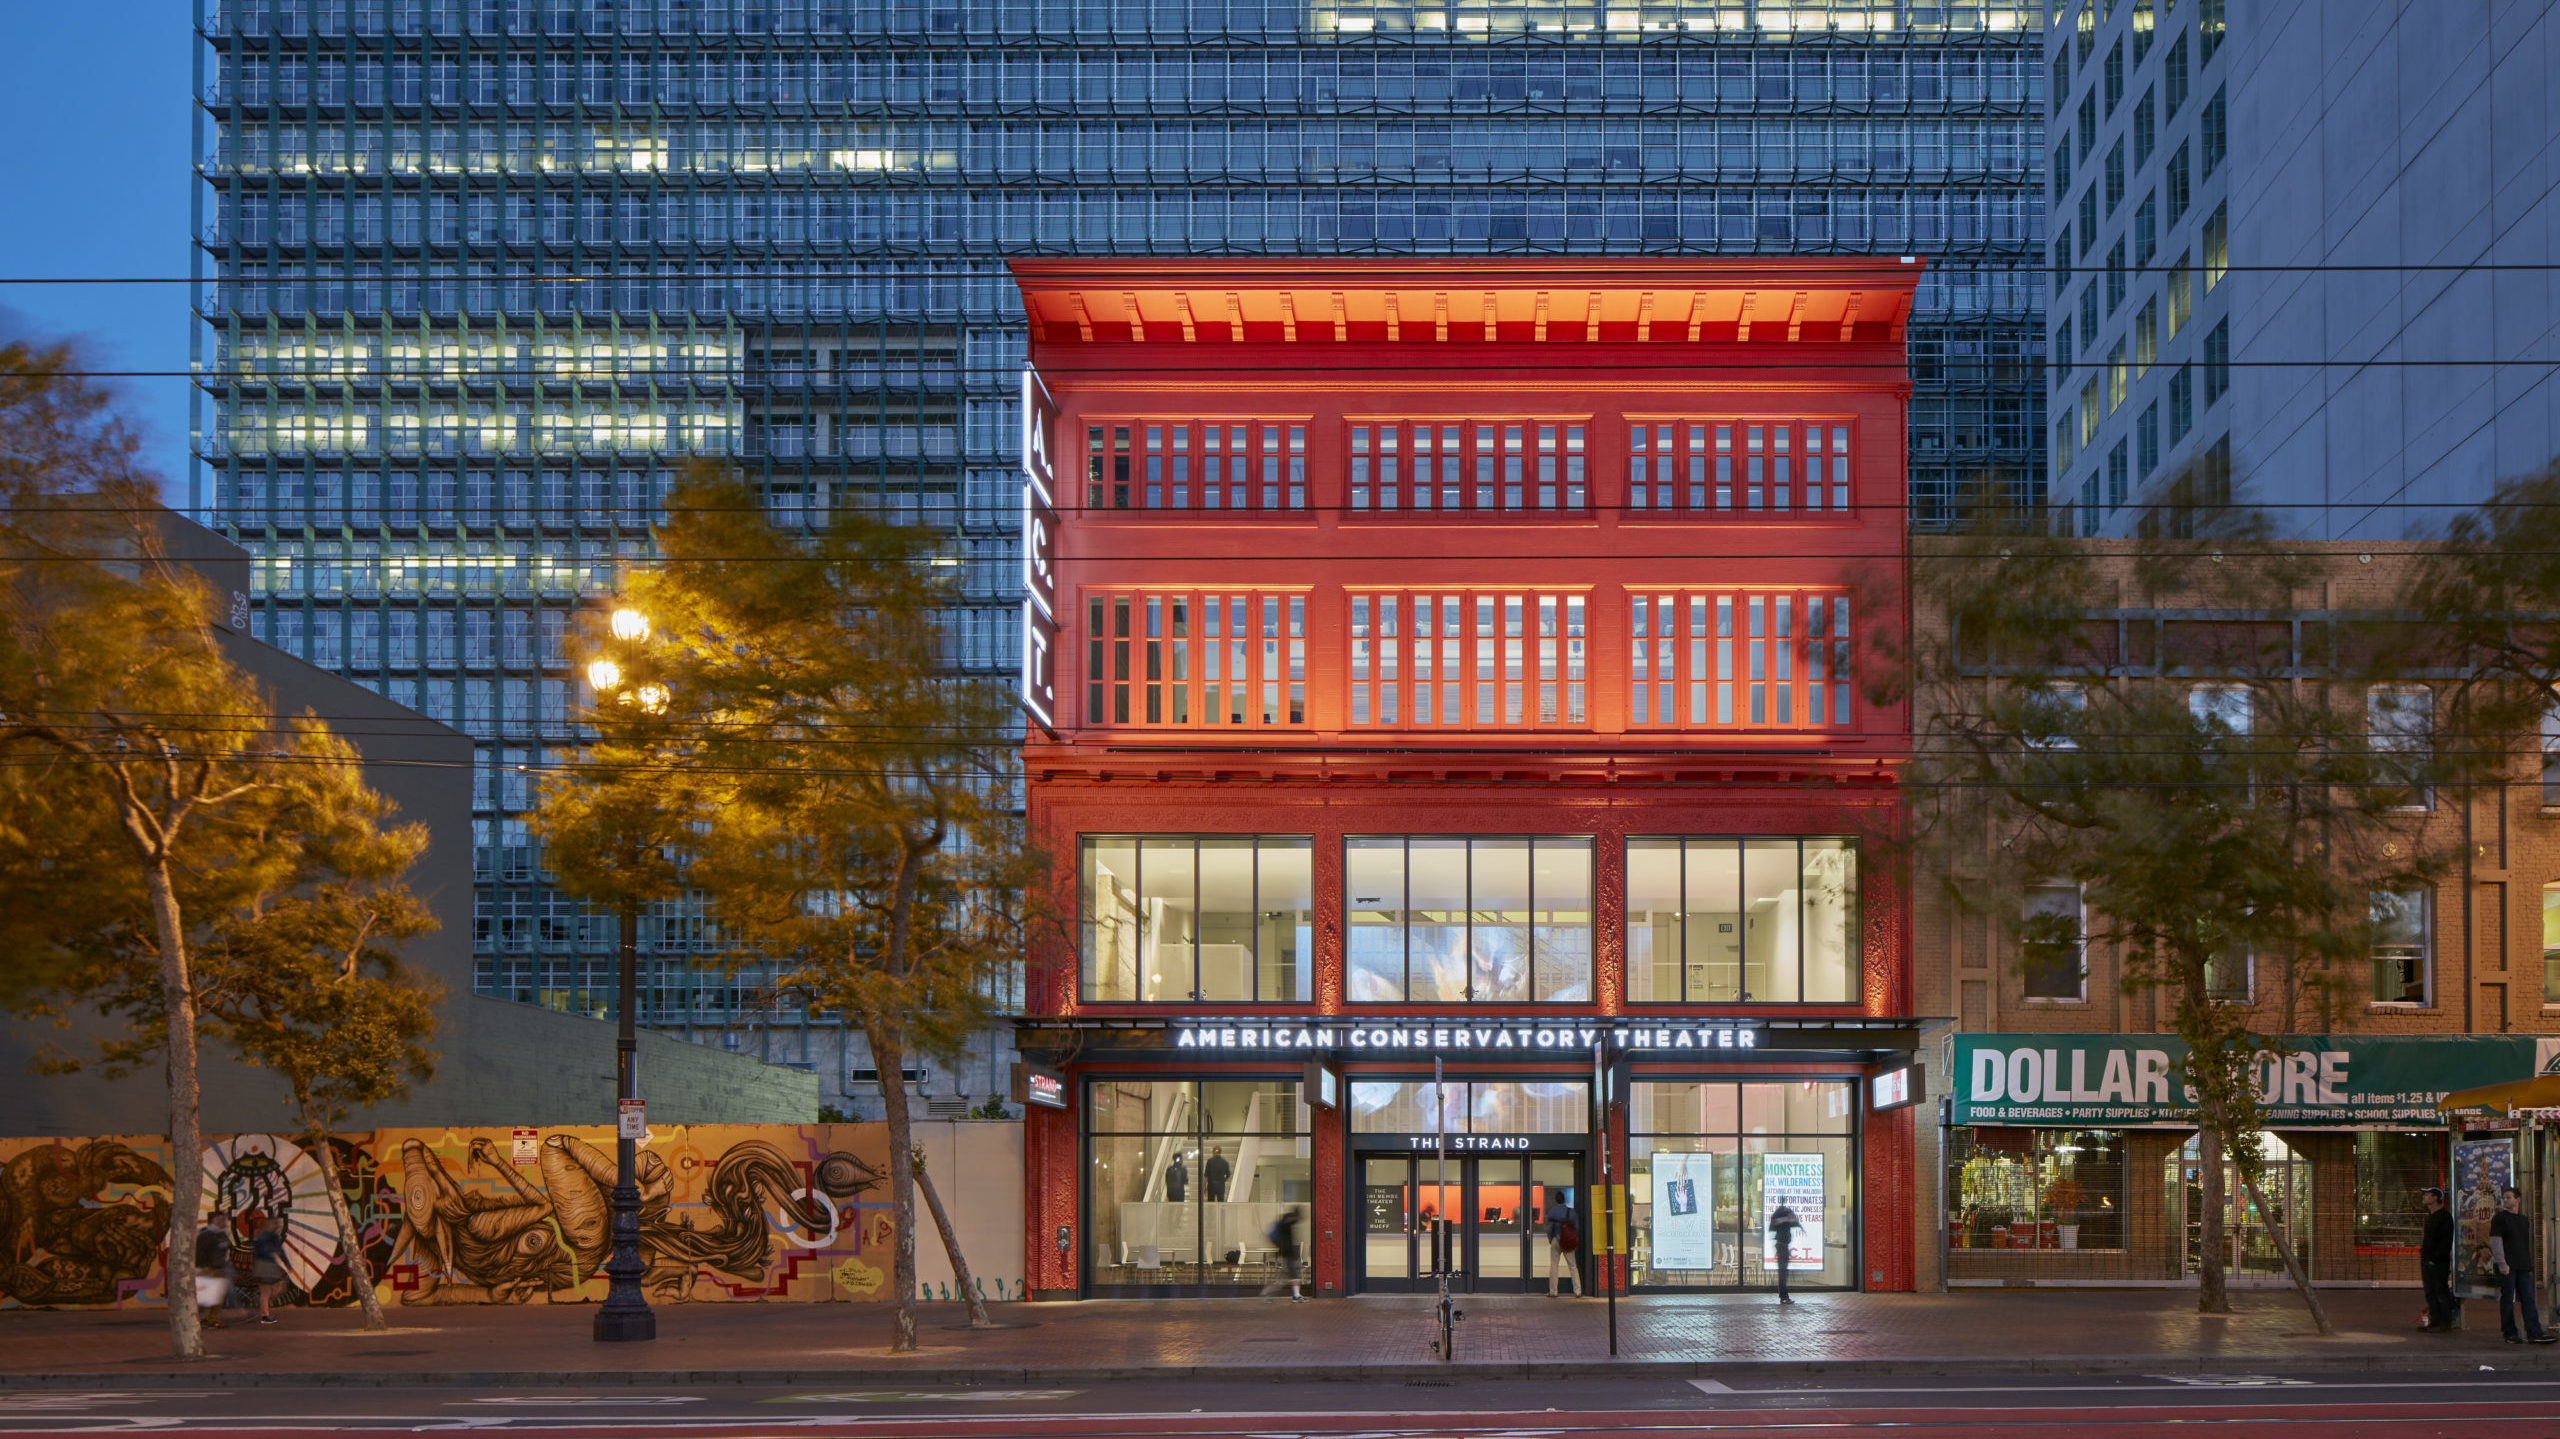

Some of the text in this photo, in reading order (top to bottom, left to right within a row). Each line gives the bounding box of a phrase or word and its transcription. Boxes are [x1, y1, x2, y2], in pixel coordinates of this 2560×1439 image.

[1178, 1028, 1756, 1048] AMERICAN CONSERVATORY THEATER
[1971, 1048, 2170, 1103] DOLLAR
[1035, 1074, 1057, 1093] STRAND
[2351, 1092, 2365, 1104] all
[2367, 1092, 2396, 1104] items
[2397, 1092, 2423, 1104] $1.25
[2425, 1092, 2435, 1104] &
[1970, 1107, 1996, 1118] FOOD
[1997, 1107, 2007, 1118] &
[2008, 1107, 2064, 1118] BEVERAGES
[2072, 1107, 2104, 1118] PARTY
[2105, 1107, 2150, 1118] SUPPLIES
[2255, 1108, 2300, 1119] CEANING
[2301, 1109, 2347, 1119] SUPPLIES
[2354, 1109, 2391, 1119] SCHOOL
[2391, 1109, 2437, 1119] SUPPLIES
[1455, 1137, 1529, 1149] STRAND
[1765, 1163, 1824, 1177] MONSTRESS
[1765, 1195, 1824, 1205] THE UNFORTUNATES
